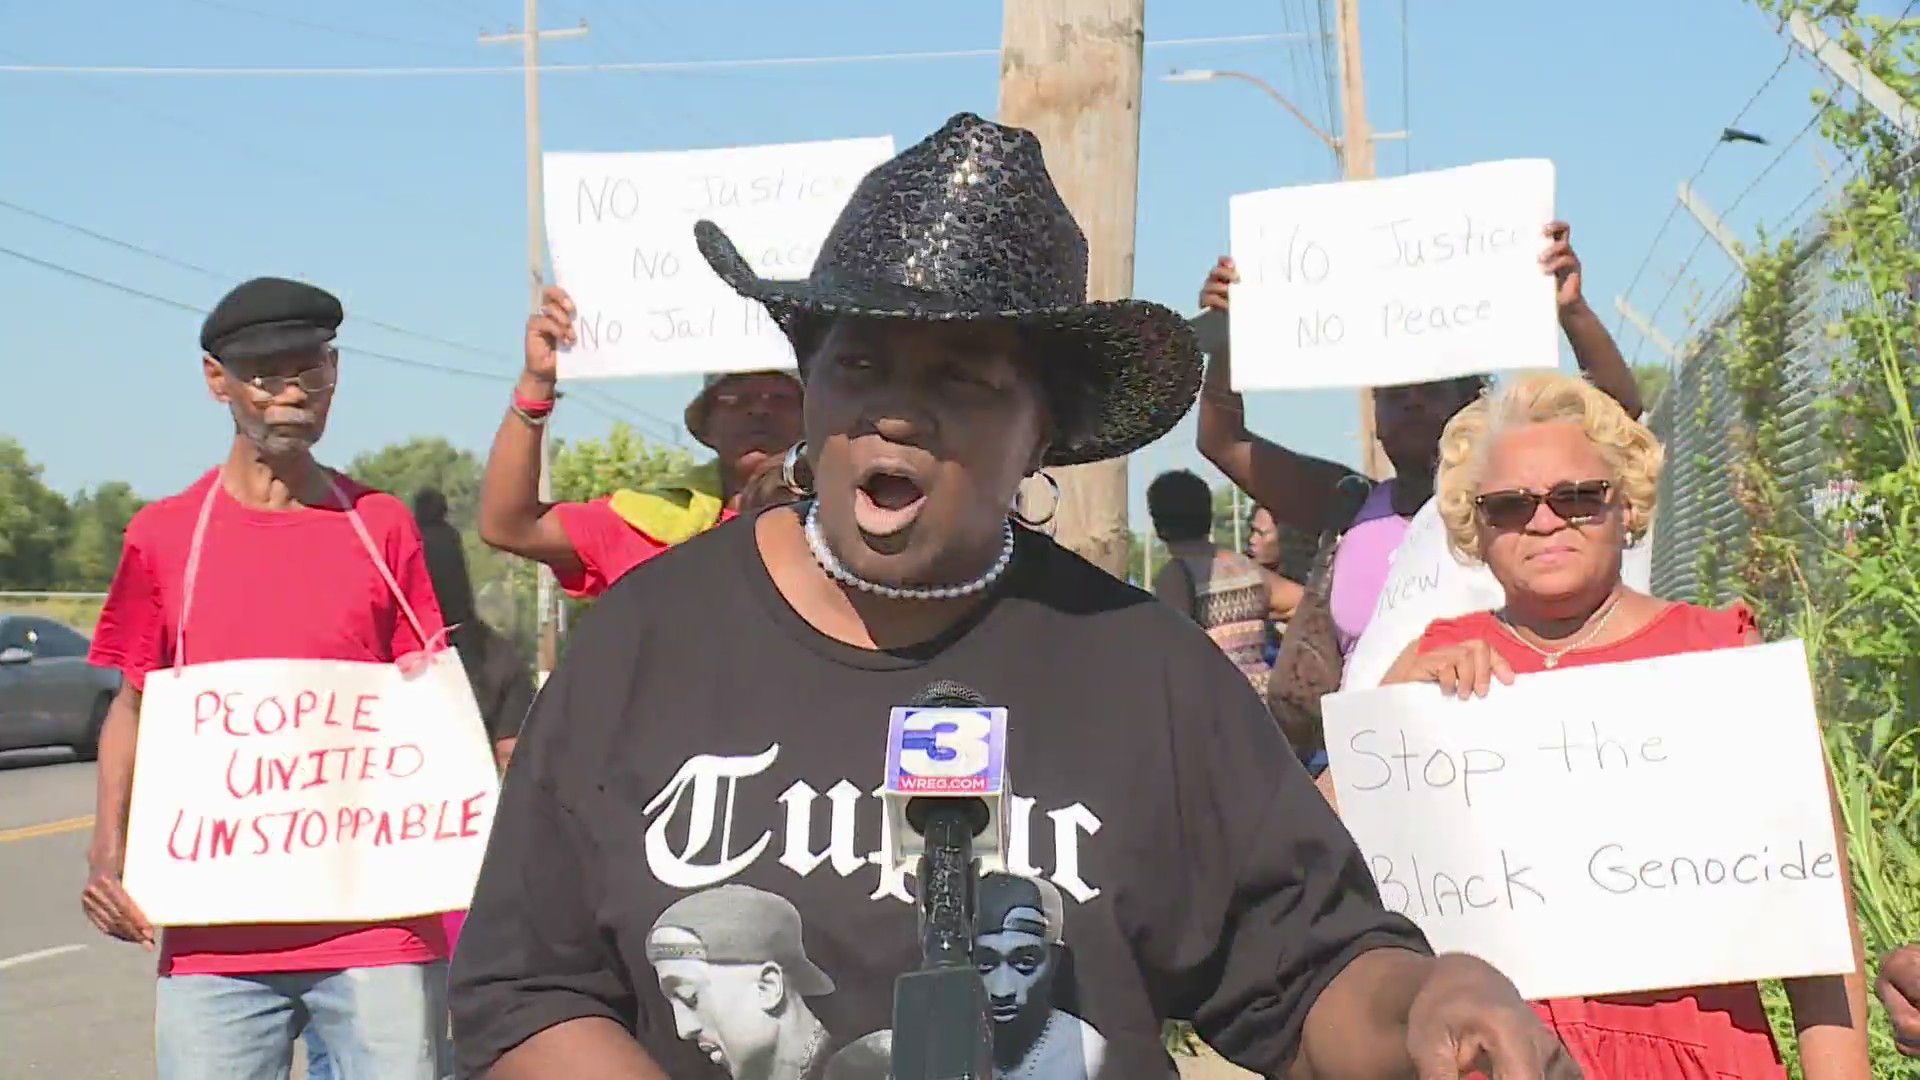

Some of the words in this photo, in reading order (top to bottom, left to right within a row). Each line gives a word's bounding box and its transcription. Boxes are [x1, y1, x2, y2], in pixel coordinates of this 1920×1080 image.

[1383, 299, 1492, 341] Peace
[194, 690, 380, 737] PEOPLE
[225, 743, 424, 799] UNITED
[900, 711, 990, 777] 3
[1350, 729, 1506, 807] Stop
[1538, 721, 1669, 773] the
[901, 778, 985, 789] WREG.COM
[167, 792, 487, 861] UNSTOPPABLE
[1588, 841, 1836, 894] Genocide
